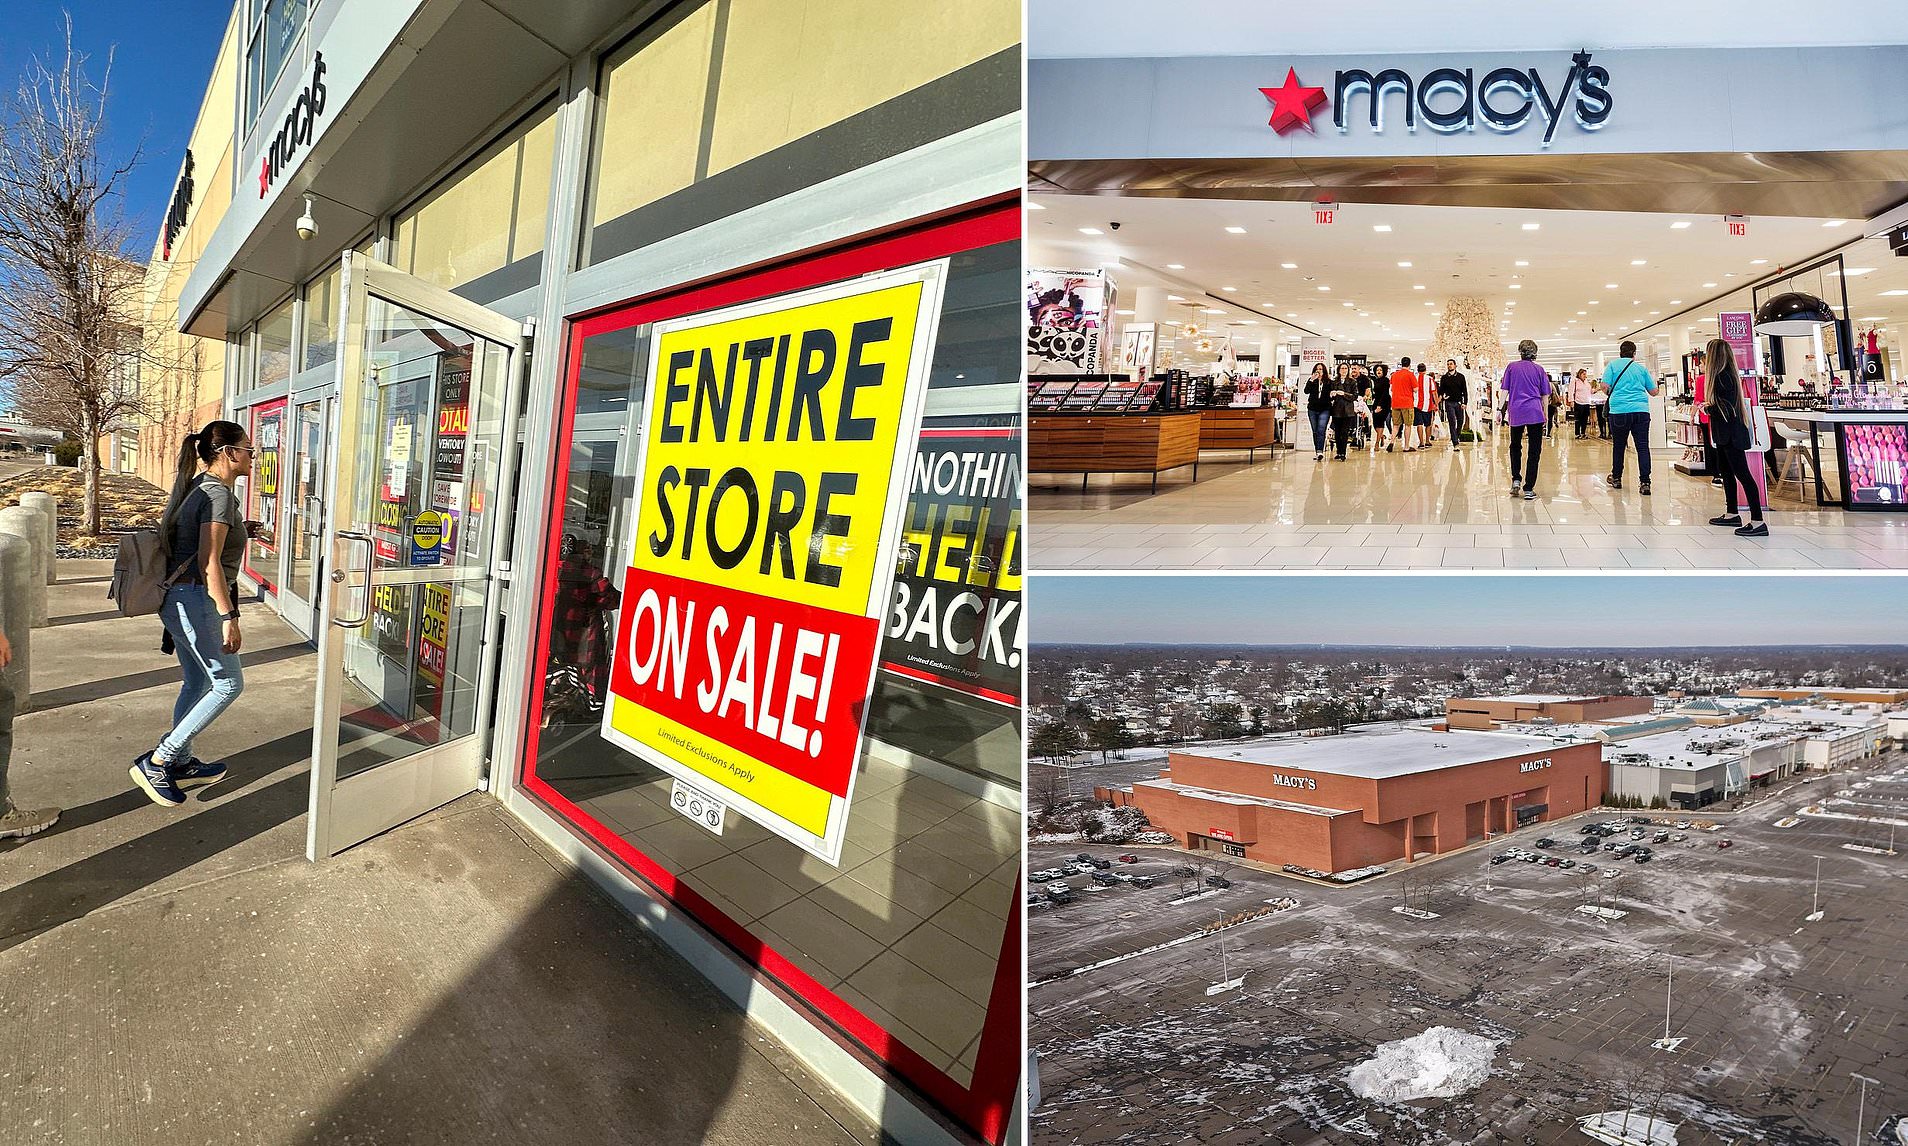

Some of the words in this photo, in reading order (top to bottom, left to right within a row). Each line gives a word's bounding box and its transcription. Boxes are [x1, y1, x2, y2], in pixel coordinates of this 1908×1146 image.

[1333, 48, 1613, 149] macy's
[1726, 320, 1747, 328] FREE
[660, 317, 894, 443] ENTIRE
[439, 406, 469, 432] OTAL
[438, 438, 465, 450] VENTORY
[437, 483, 450, 492] SAVE
[648, 465, 859, 588] STORE
[424, 587, 449, 616] TIRE
[421, 613, 446, 642] ORE
[629, 588, 696, 700] ON
[697, 605, 841, 758] SALE!
[907, 653, 929, 667] Limited
[657, 727, 686, 749] Limited
[685, 740, 728, 769] Exclusions
[728, 762, 756, 784] Apply
